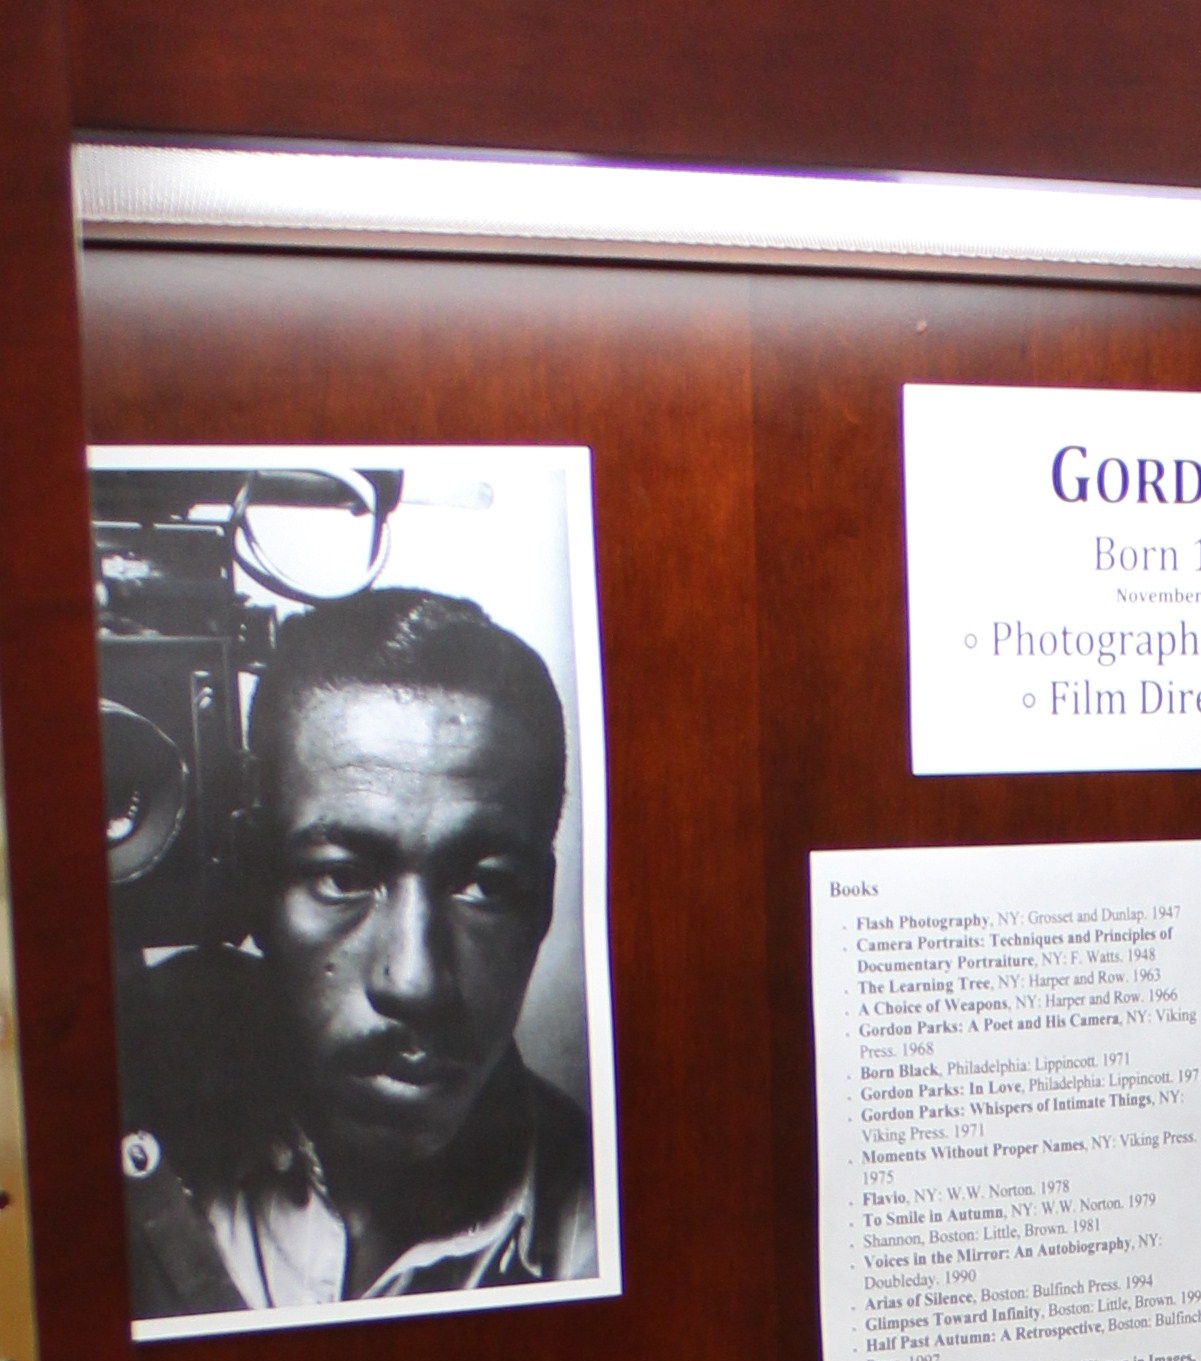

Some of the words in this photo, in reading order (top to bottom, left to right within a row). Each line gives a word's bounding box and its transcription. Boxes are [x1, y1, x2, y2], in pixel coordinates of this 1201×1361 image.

[1096, 537, 1177, 571] Born
[1117, 588, 1201, 603] November
[1052, 680, 1126, 715] Film
[830, 881, 878, 897] Books
[857, 916, 893, 930] Flash
[998, 912, 1024, 924] NY:
[1028, 911, 1072, 924] Grosset
[1077, 908, 1097, 922] and
[1153, 905, 1180, 919] 1947
[856, 938, 912, 952] Camera
[918, 934, 984, 949] Portraits:
[989, 932, 1063, 948] Techniques
[1068, 930, 1090, 943] and
[1095, 927, 1156, 944] Principles
[1159, 926, 1173, 940] of
[859, 1003, 869, 1015] A
[874, 1000, 921, 1015] Choice
[926, 998, 940, 1013] of
[1016, 995, 1040, 1008] NY:
[1046, 993, 1085, 1009] Harper
[1089, 991, 1110, 1005] and
[1150, 988, 1177, 1002] 1966
[861, 1066, 894, 1080] Born
[947, 1058, 1030, 1075] Philadelphia:
[1104, 1052, 1128, 1066] 1971
[864, 1254, 909, 1268] Voices
[913, 1252, 926, 1265] in
[931, 1251, 952, 1264] the
[957, 1248, 1009, 1262] Mirror:
[1014, 1245, 1032, 1258] An
[1138, 1233, 1161, 1247] NY:
